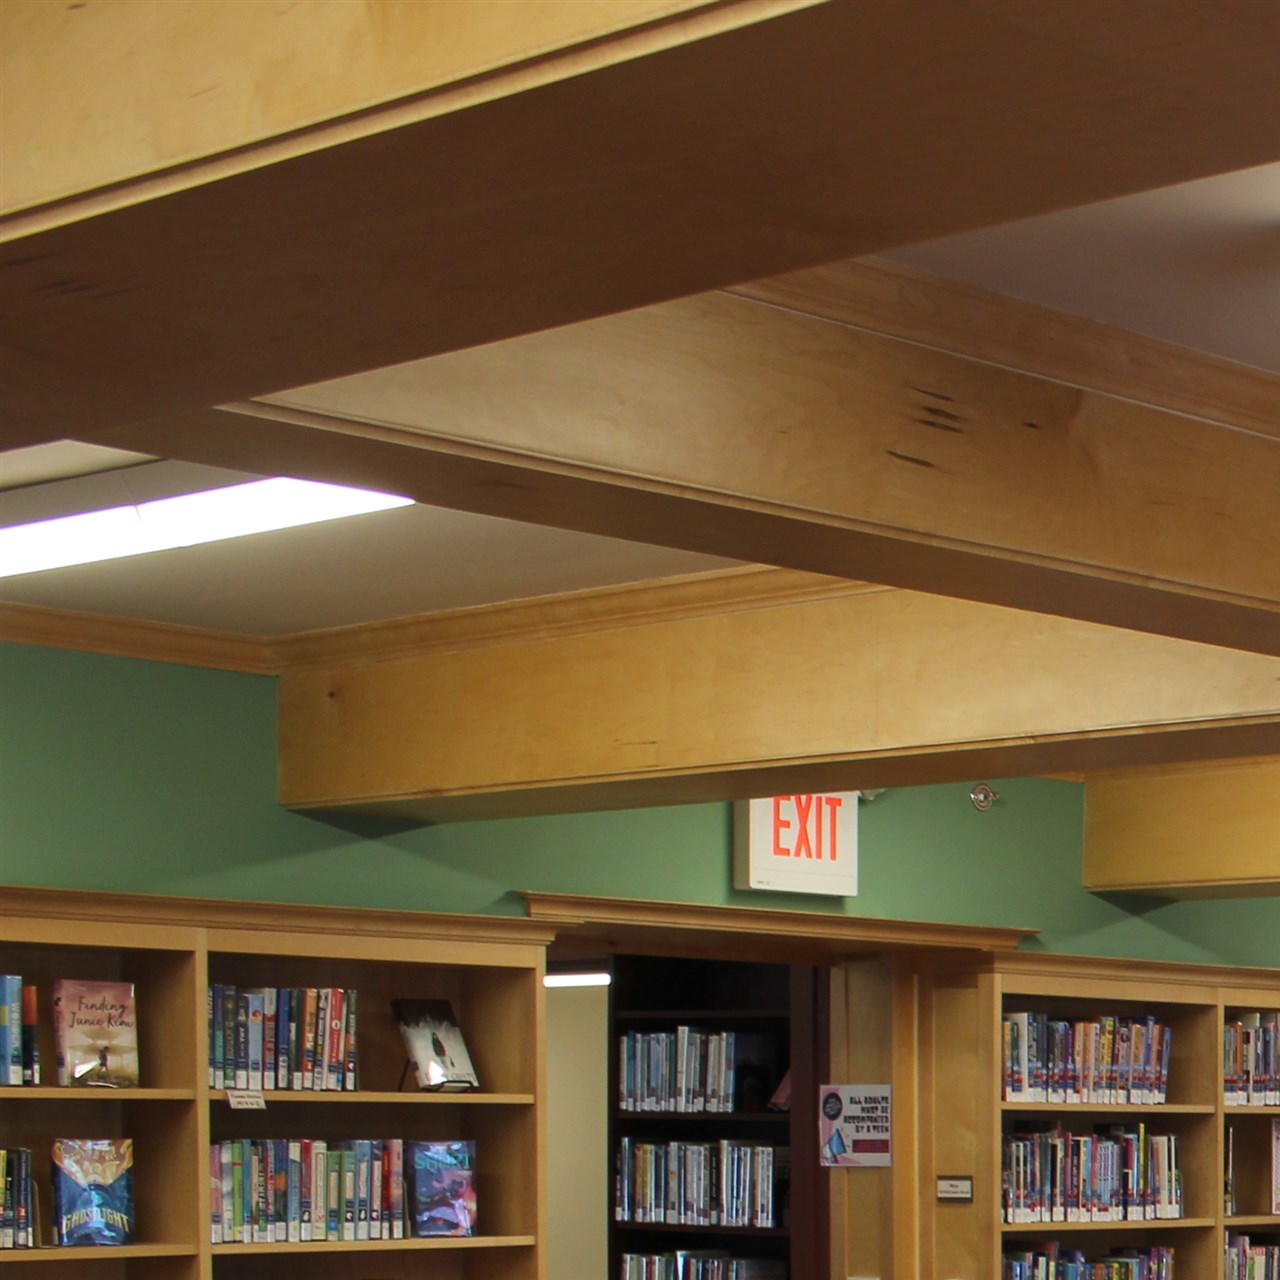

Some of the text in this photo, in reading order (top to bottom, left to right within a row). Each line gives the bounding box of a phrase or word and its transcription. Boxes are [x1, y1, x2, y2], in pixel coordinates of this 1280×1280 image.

[772, 794, 842, 861] EXIT
[77, 996, 128, 1018] Finding
[69, 1011, 134, 1028] Junie Kim
